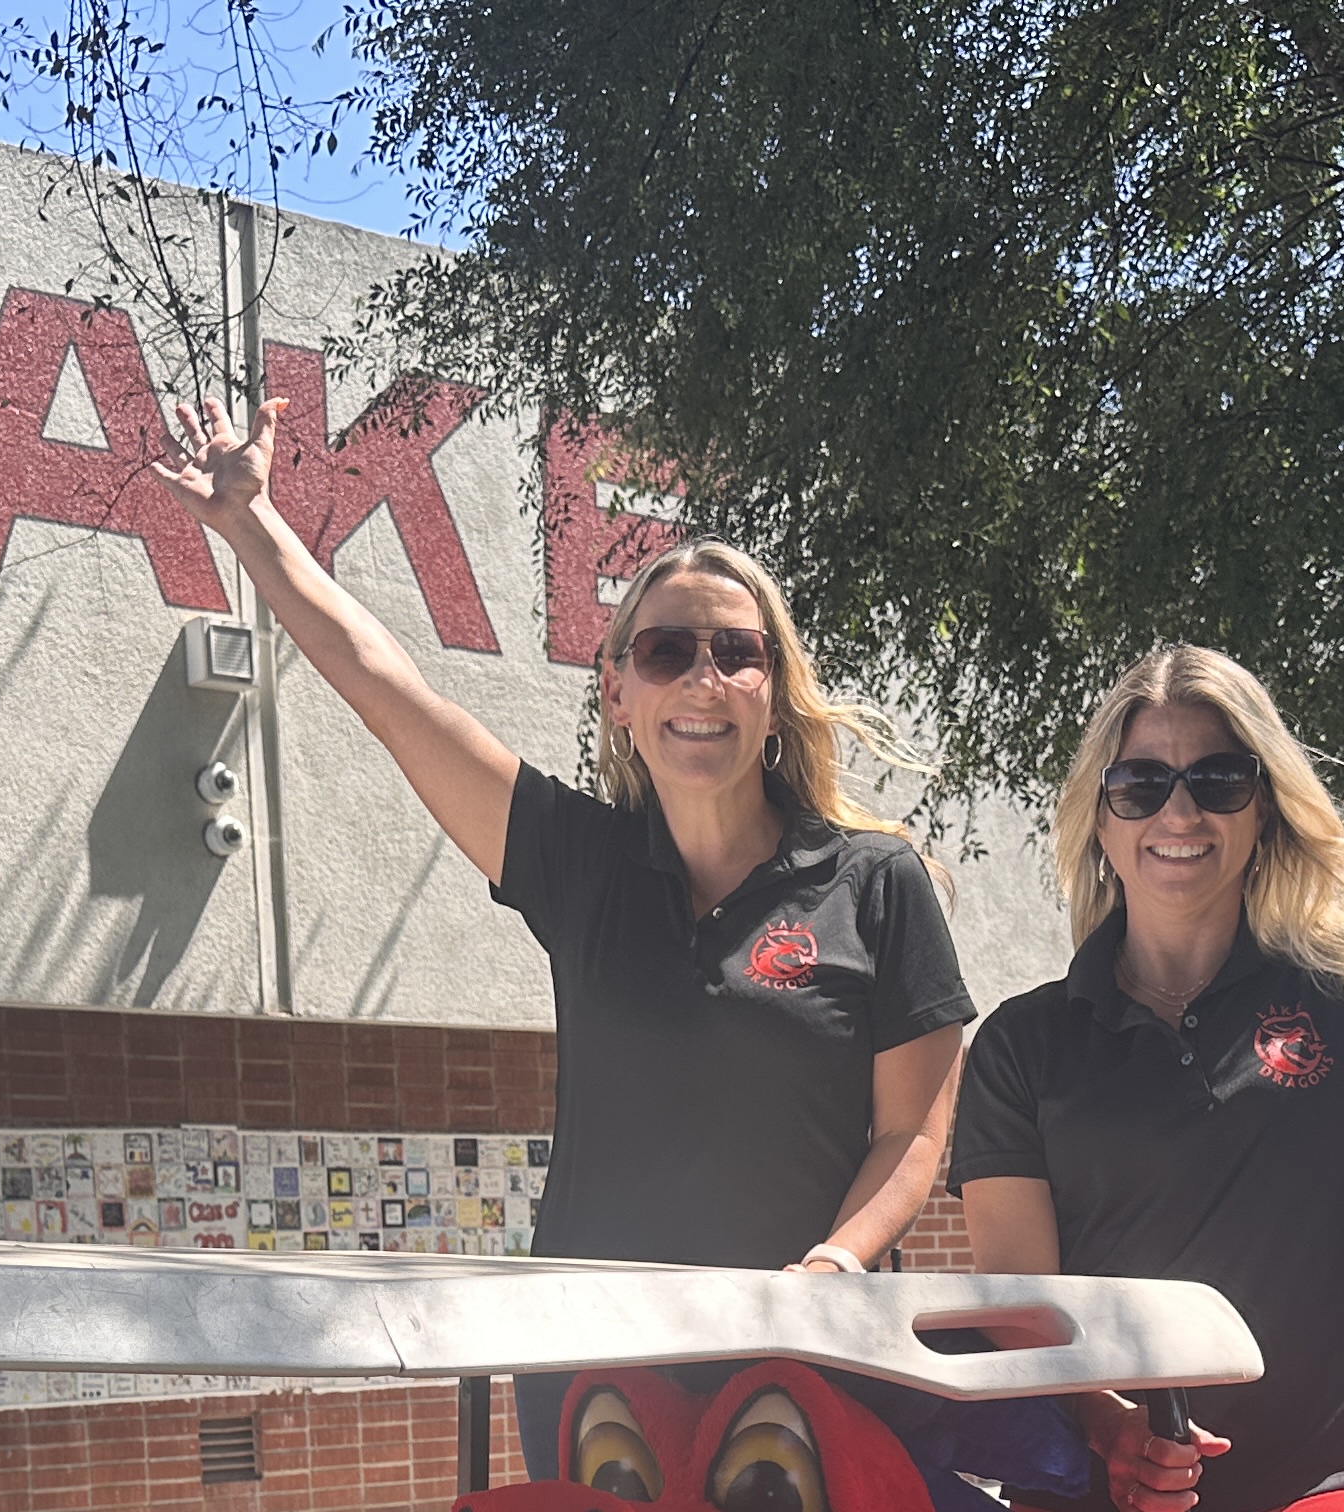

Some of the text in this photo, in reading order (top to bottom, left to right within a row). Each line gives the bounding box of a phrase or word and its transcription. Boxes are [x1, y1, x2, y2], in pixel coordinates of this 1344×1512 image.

[766, 920, 814, 932] LAKE
[742, 965, 814, 990] DRAGONS
[1256, 1001, 1304, 1019] LAKE
[1258, 1055, 1335, 1089] DRAGONS
